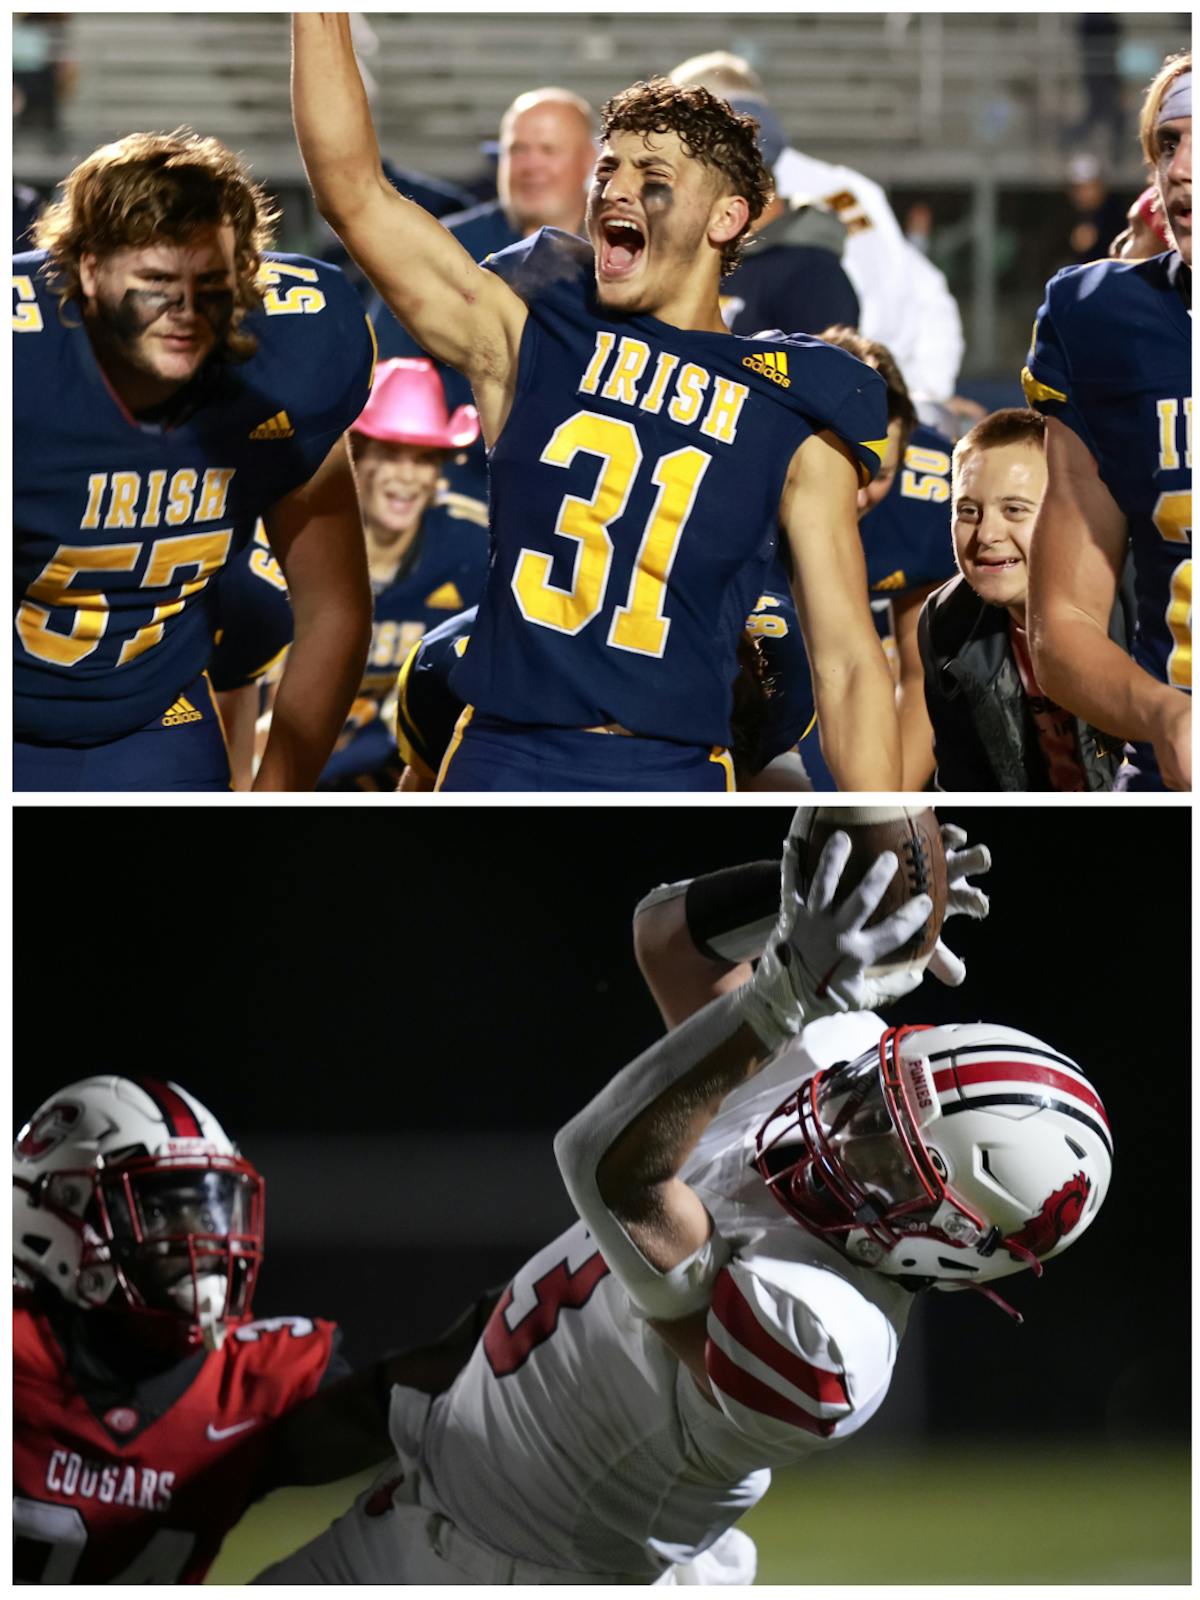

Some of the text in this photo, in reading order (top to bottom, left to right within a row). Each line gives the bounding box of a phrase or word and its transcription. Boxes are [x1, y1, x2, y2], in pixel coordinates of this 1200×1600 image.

[255, 262, 327, 316] 57
[578, 331, 749, 445] IRISH
[742, 356, 791, 388] adidas
[80, 467, 236, 530] IRISH
[901, 445, 951, 503] 50
[511, 410, 713, 658] 31
[15, 528, 234, 668] 57
[161, 710, 204, 727] adidas
[907, 1059, 933, 1109] PONIES
